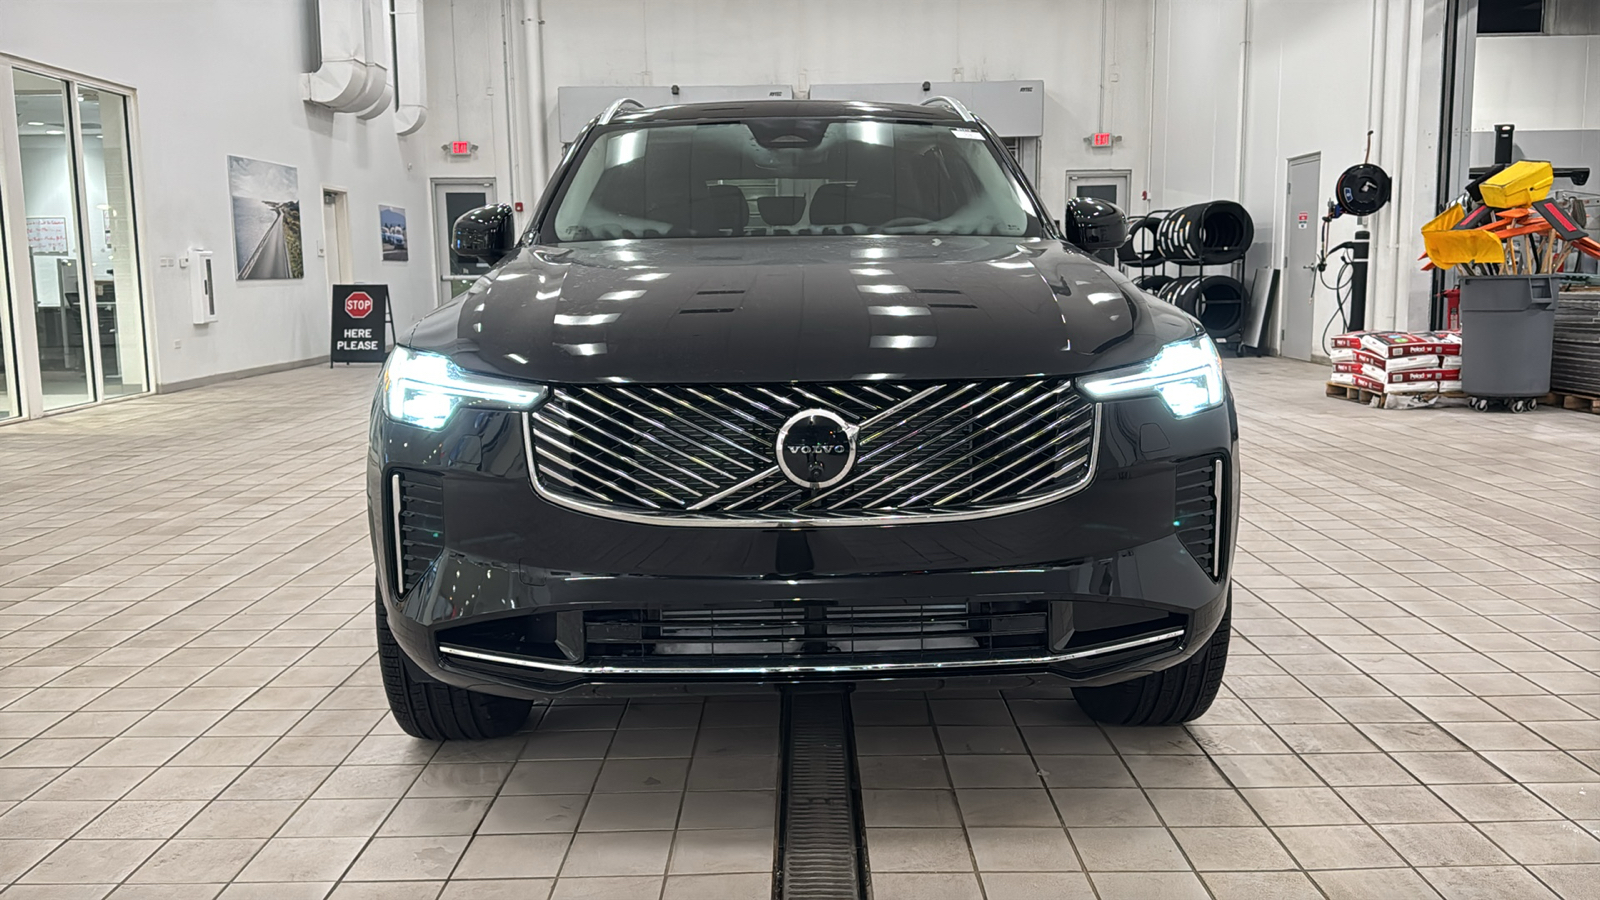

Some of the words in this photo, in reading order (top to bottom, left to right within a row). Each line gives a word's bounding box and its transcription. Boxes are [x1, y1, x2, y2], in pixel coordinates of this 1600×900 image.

[1094, 133, 1110, 145] EXIT
[347, 300, 371, 310] STOP
[344, 329, 372, 338] HERE
[337, 341, 378, 350] PLEASE
[787, 445, 845, 454] VOLVO
